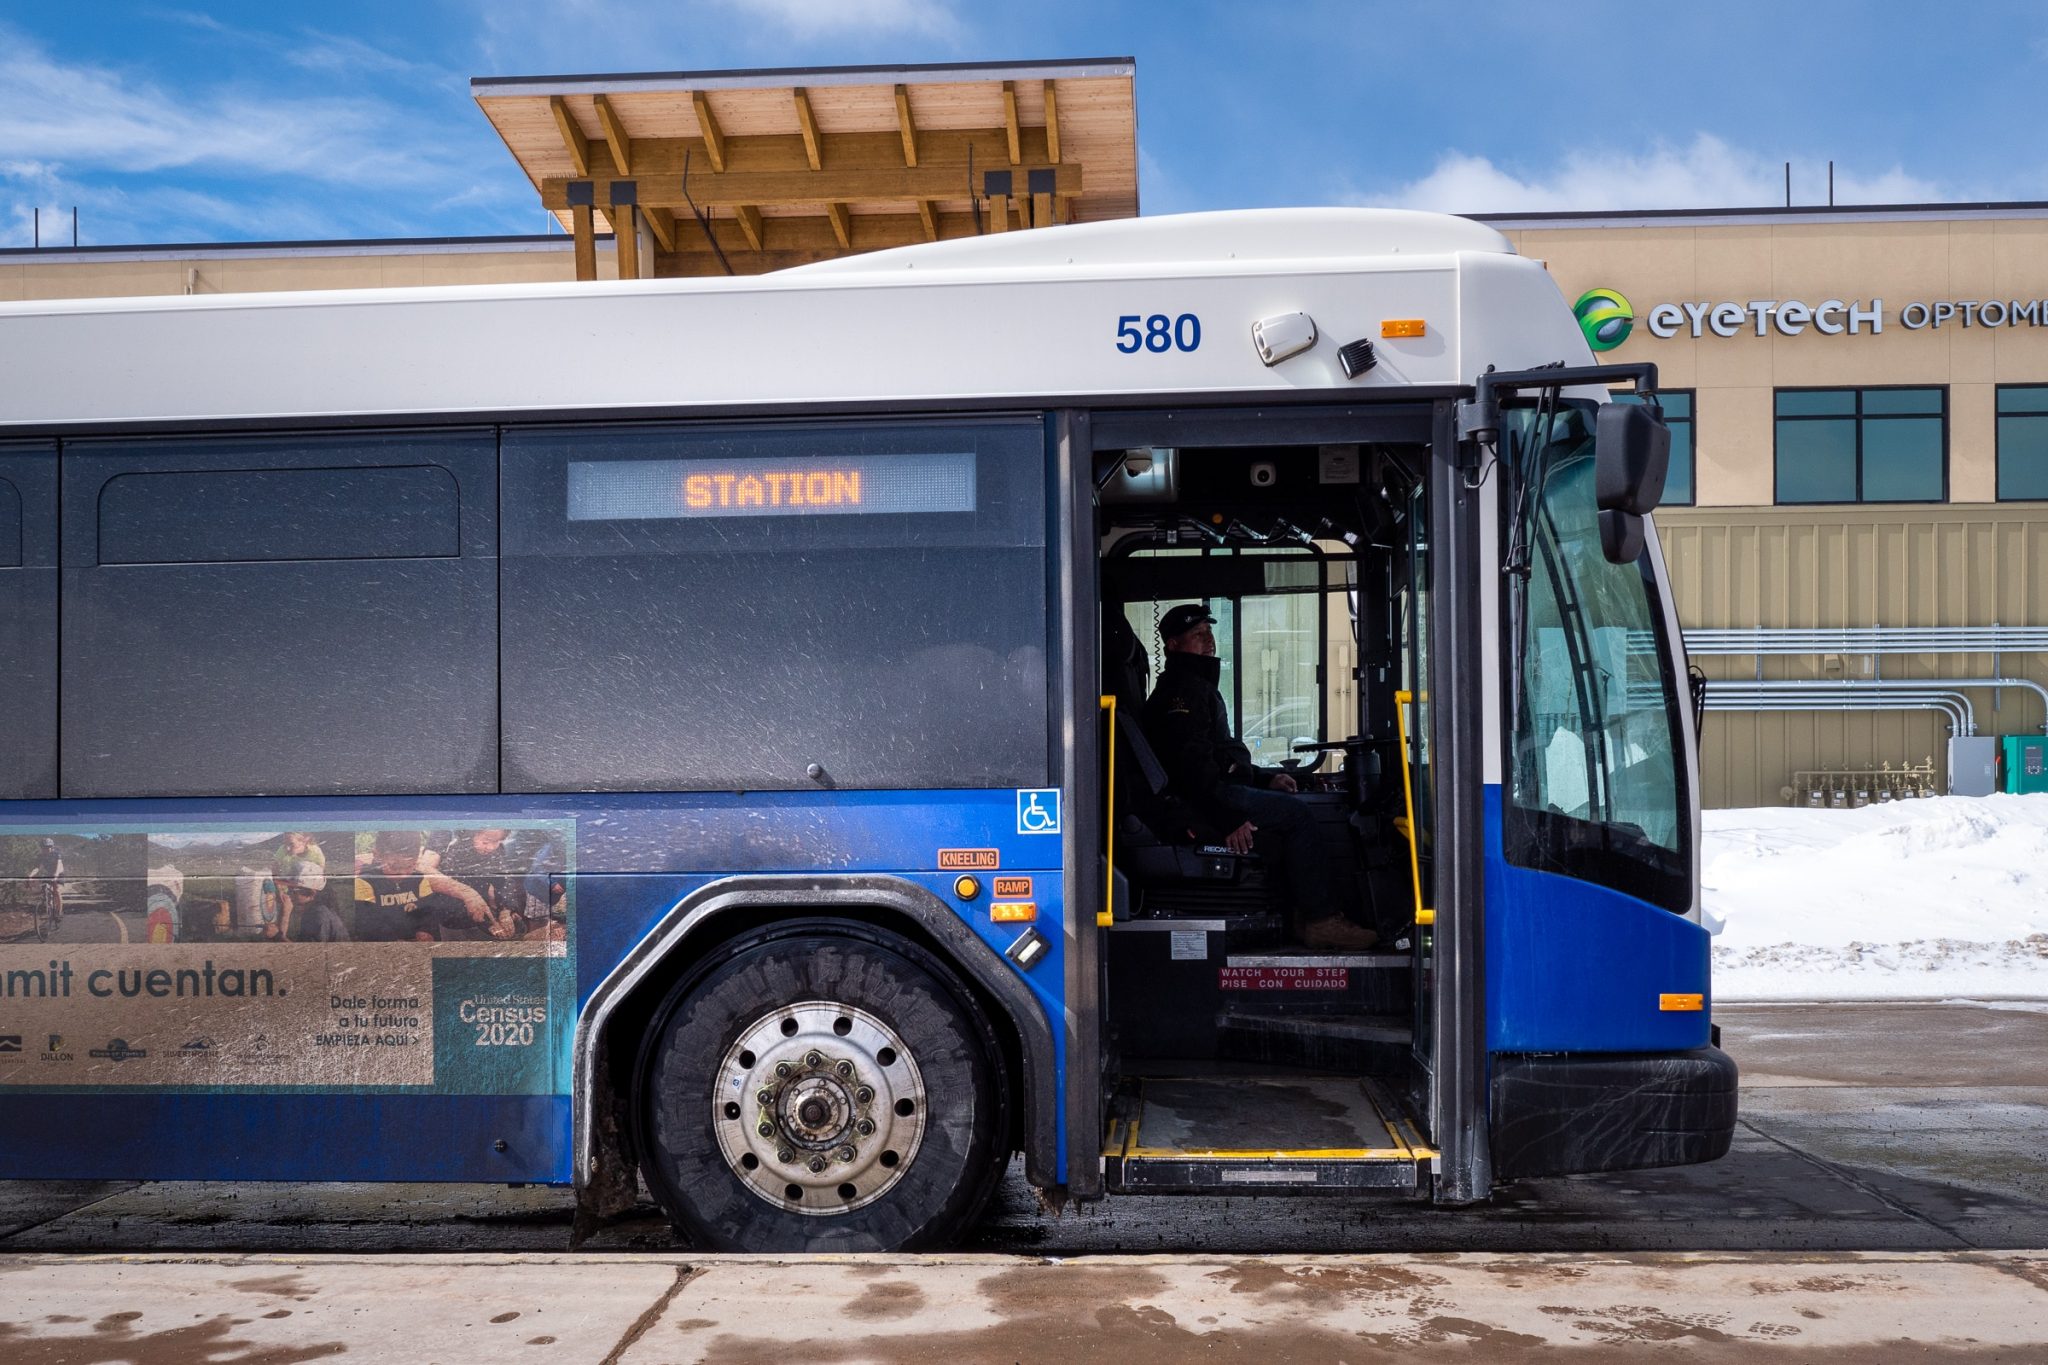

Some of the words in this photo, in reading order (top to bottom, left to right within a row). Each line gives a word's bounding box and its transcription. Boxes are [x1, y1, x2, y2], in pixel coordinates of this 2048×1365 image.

[1116, 313, 1201, 354] 580
[686, 471, 860, 506] STATION
[942, 852, 995, 866] KNEELING
[997, 881, 1029, 893] RAMP
[380, 891, 418, 907] IOWA
[0, 960, 73, 998] mit
[88, 960, 287, 998] cuentan.
[1221, 968, 1262, 977] WATCH
[1273, 968, 1305, 977] YOUR
[1316, 968, 1346, 977] STEP
[1221, 979, 1248, 988] PISE
[1259, 979, 1283, 988] CON
[1294, 979, 1347, 988] CUIDADO
[331, 995, 367, 1009] Dale
[372, 995, 419, 1009] forma
[474, 994, 511, 1005] United
[513, 994, 546, 1005] States
[460, 999, 547, 1023] Census
[339, 1017, 349, 1028] a
[354, 1014, 369, 1028] tu
[373, 1014, 419, 1028] futuro
[315, 1034, 371, 1047] EMPIEZA
[475, 1023, 534, 1046] 2020
[41, 1053, 74, 1061] DILLON
